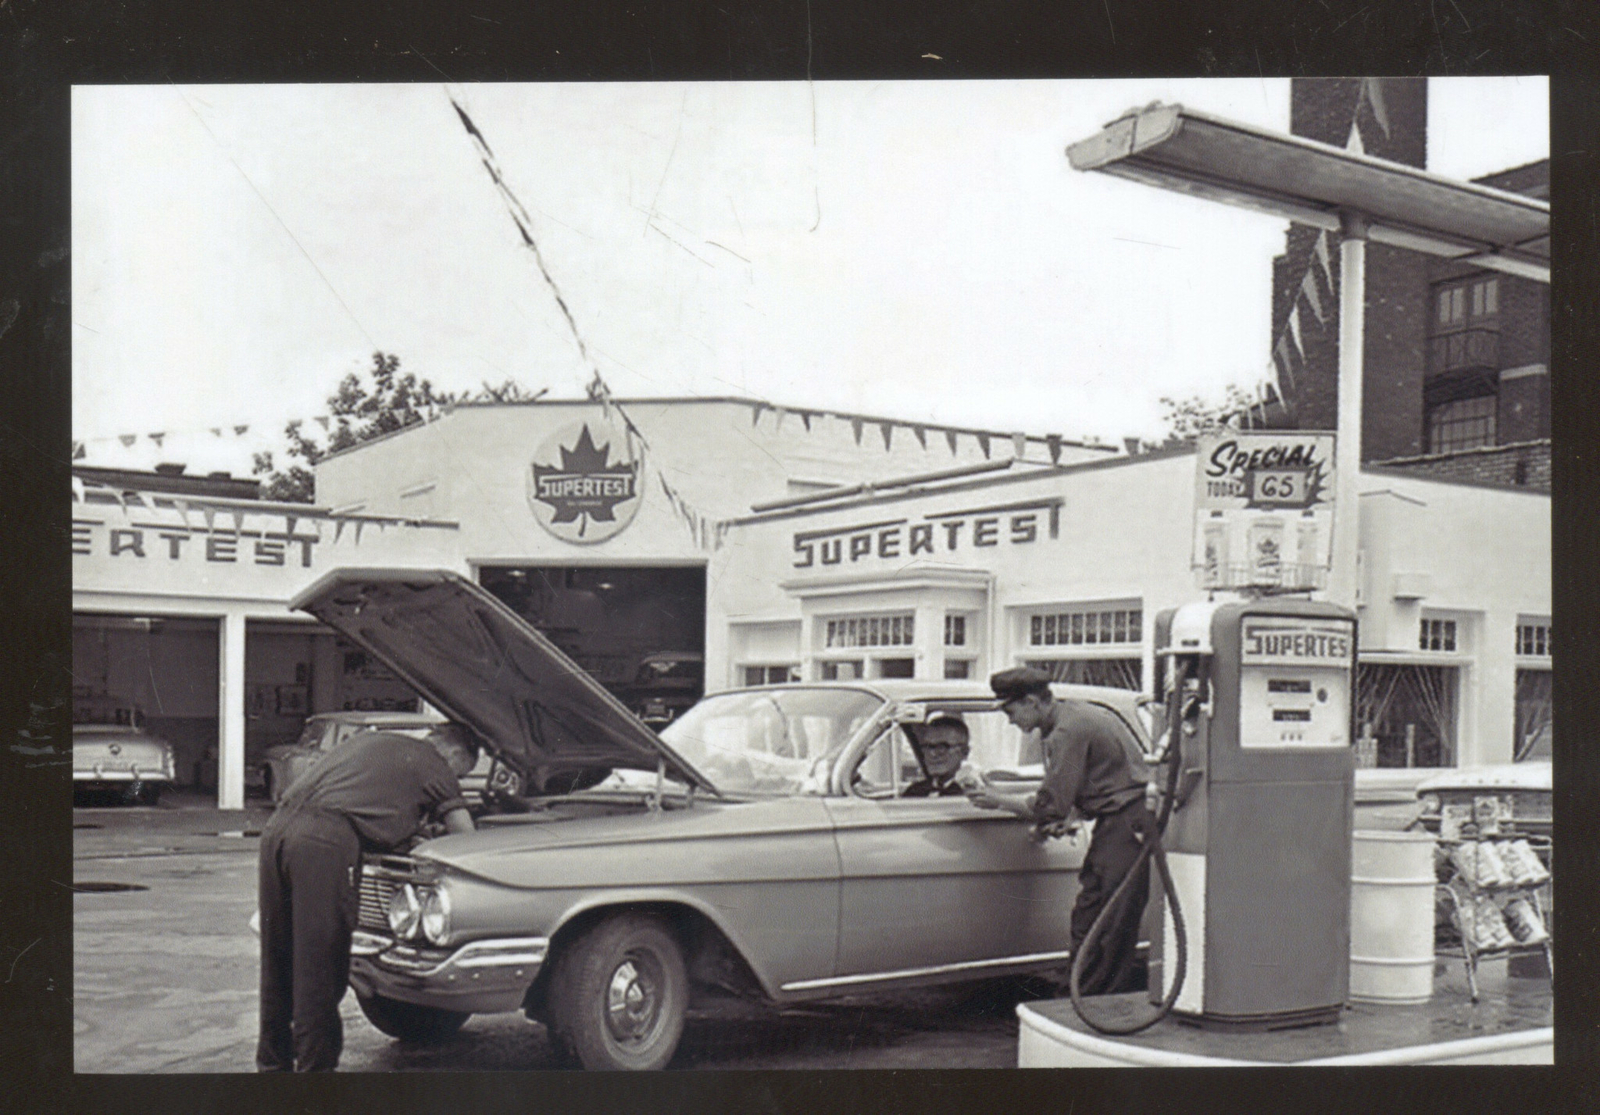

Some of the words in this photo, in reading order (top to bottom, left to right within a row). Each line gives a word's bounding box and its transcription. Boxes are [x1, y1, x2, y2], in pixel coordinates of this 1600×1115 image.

[1205, 440, 1316, 477] SPECIAL
[538, 473, 633, 498] SUPERTEST
[793, 496, 1066, 568] SUPERTEST
